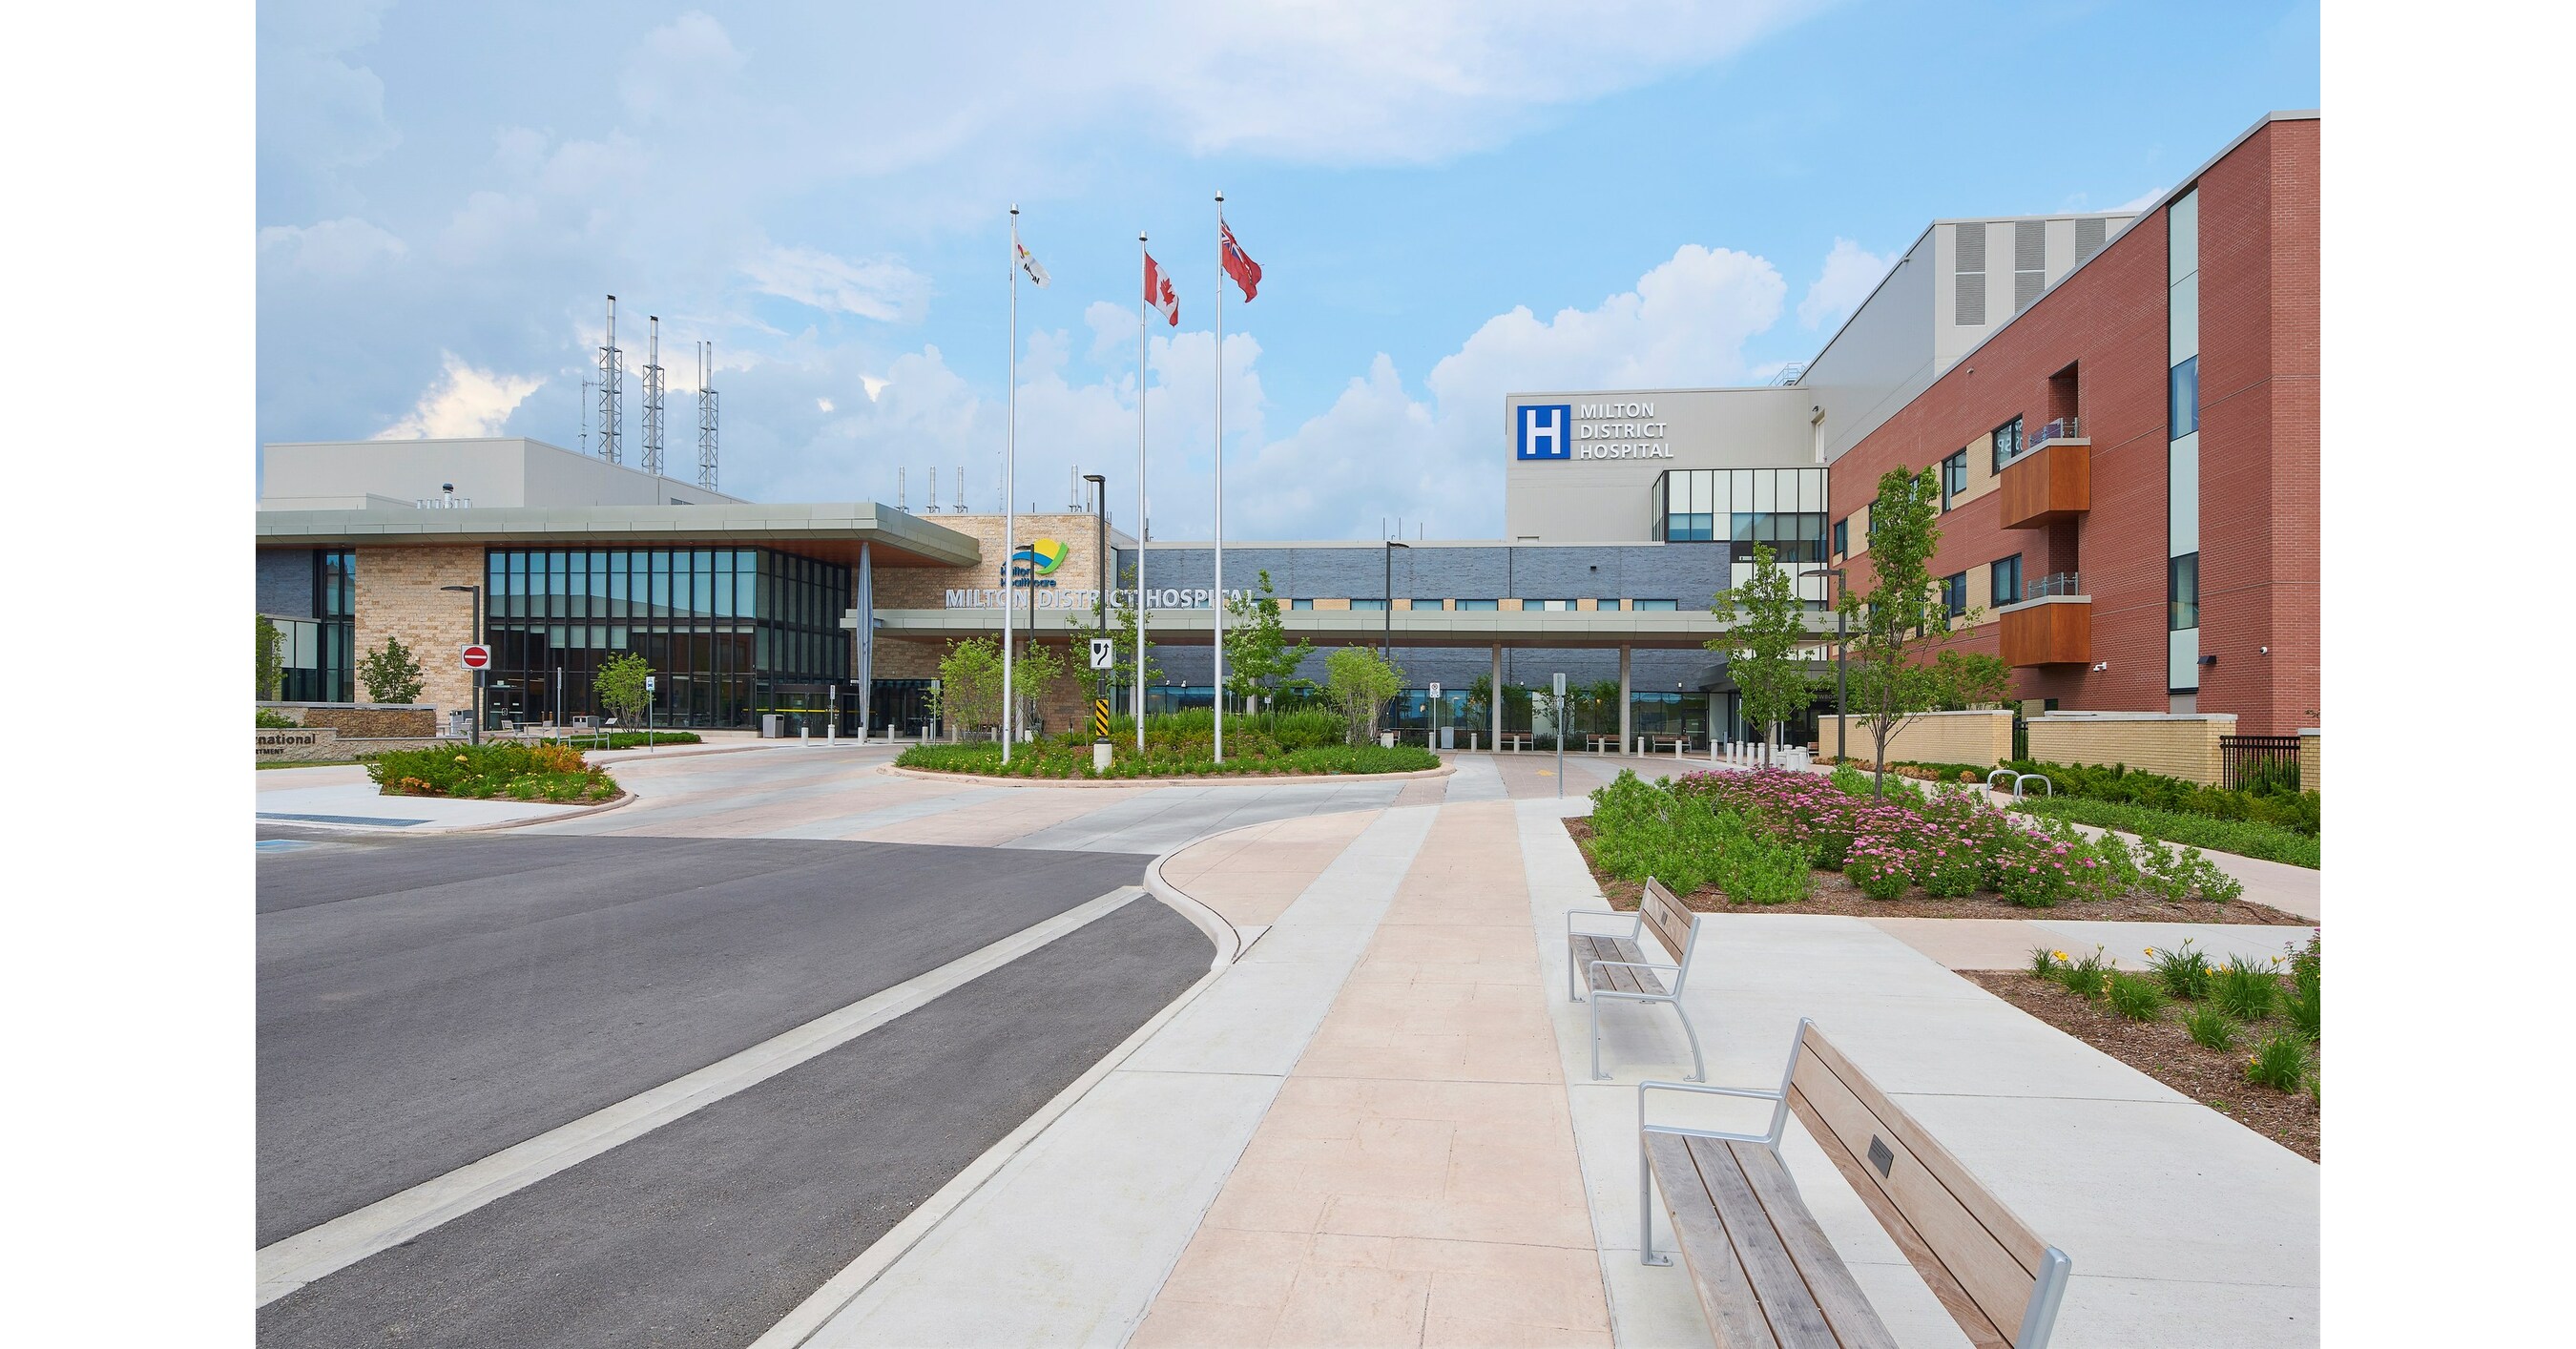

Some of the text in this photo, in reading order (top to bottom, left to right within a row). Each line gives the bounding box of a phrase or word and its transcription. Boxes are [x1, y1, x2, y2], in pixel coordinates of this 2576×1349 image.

[1580, 402, 1655, 420] MILTON
[1527, 409, 1561, 455] H
[1580, 422, 1668, 441] DISTRICT
[1579, 443, 1674, 461] HOSPITAL
[256, 734, 316, 745] national
